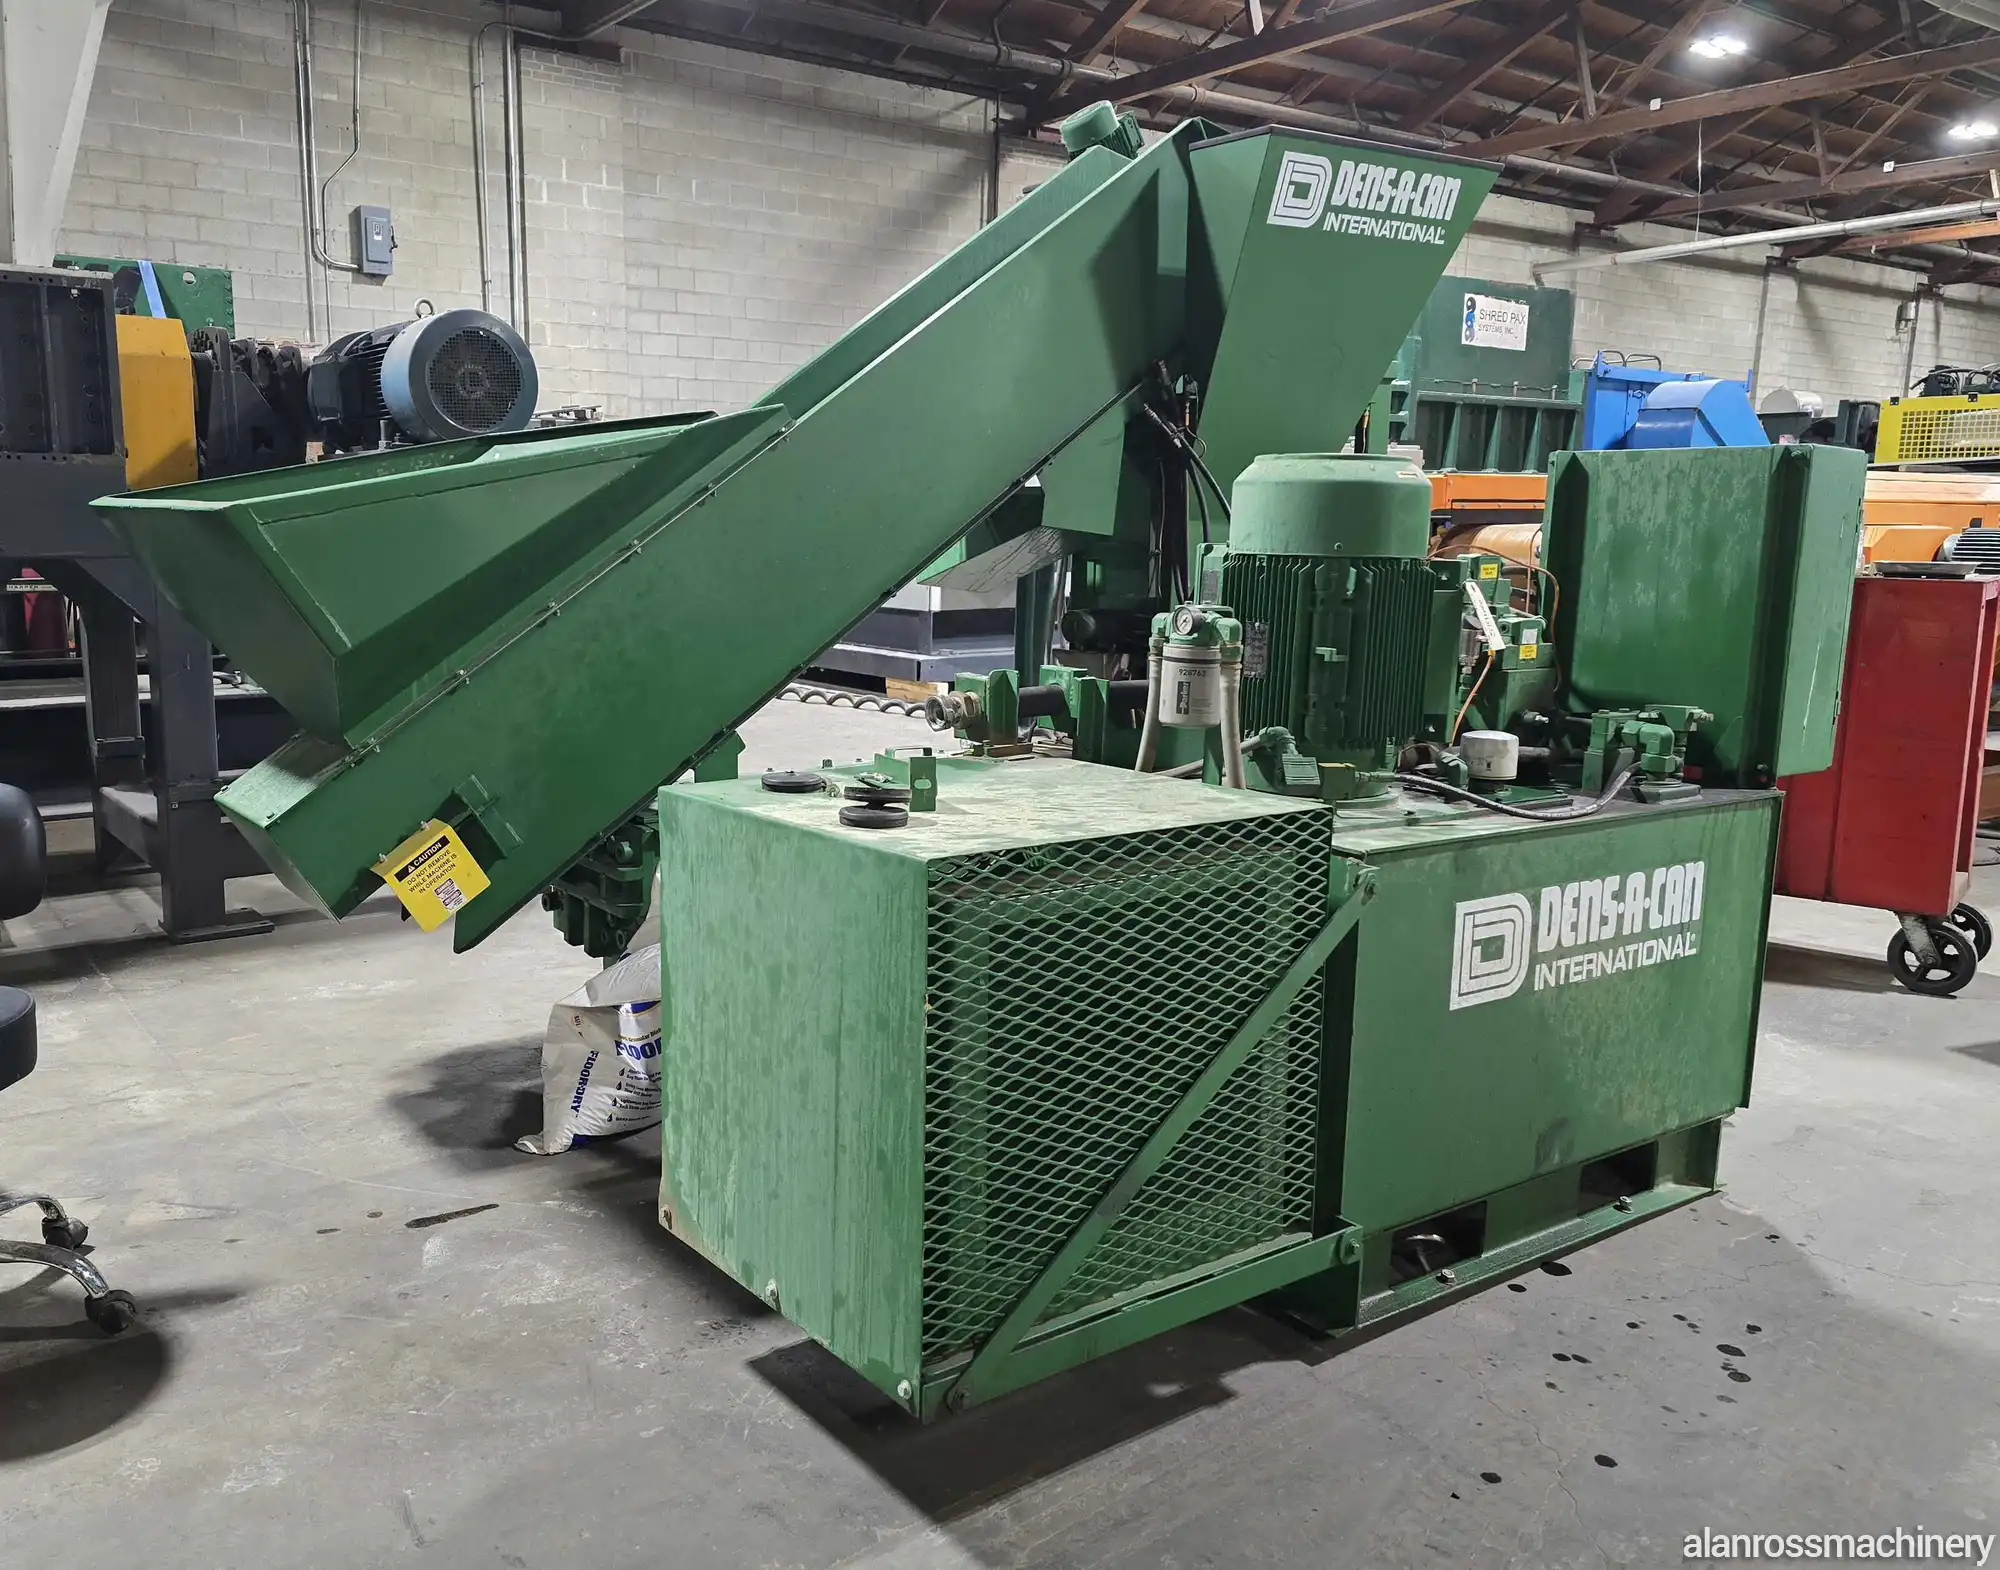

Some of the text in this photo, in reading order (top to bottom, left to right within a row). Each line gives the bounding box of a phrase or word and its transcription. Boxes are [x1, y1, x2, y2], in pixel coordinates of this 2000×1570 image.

[1323, 211, 1445, 245] INTERNATIONAL
[1479, 308, 1526, 325] SHRED PAX
[407, 849, 451, 886] DO NOT REMOVE
[413, 842, 442, 866] CAUTION
[408, 877, 426, 893] WHILE
[426, 858, 451, 881] MACHINE
[450, 853, 458, 861] IS
[418, 886, 426, 895] IN
[426, 863, 457, 889] OPERATION
[1533, 931, 1697, 991] INTERNATIONAL
[570, 1050, 599, 1114] FLOOR-DRY
